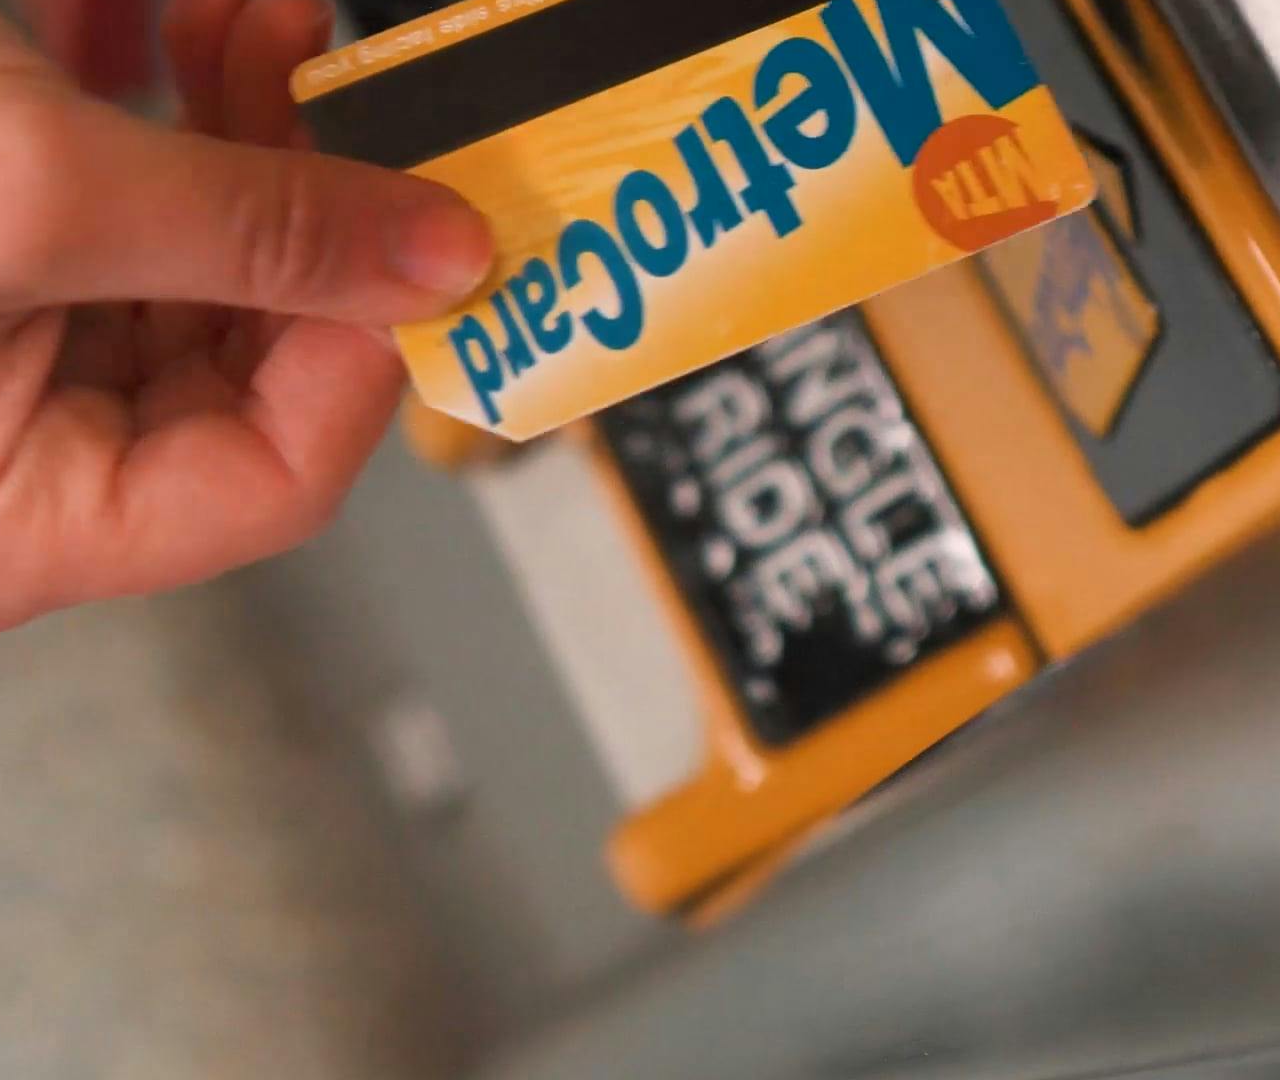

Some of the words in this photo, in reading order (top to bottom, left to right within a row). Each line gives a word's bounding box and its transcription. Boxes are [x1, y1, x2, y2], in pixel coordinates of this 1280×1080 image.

[928, 125, 1060, 221] MTA
[674, 368, 866, 630] RIDE
[756, 316, 997, 640] NGLE
